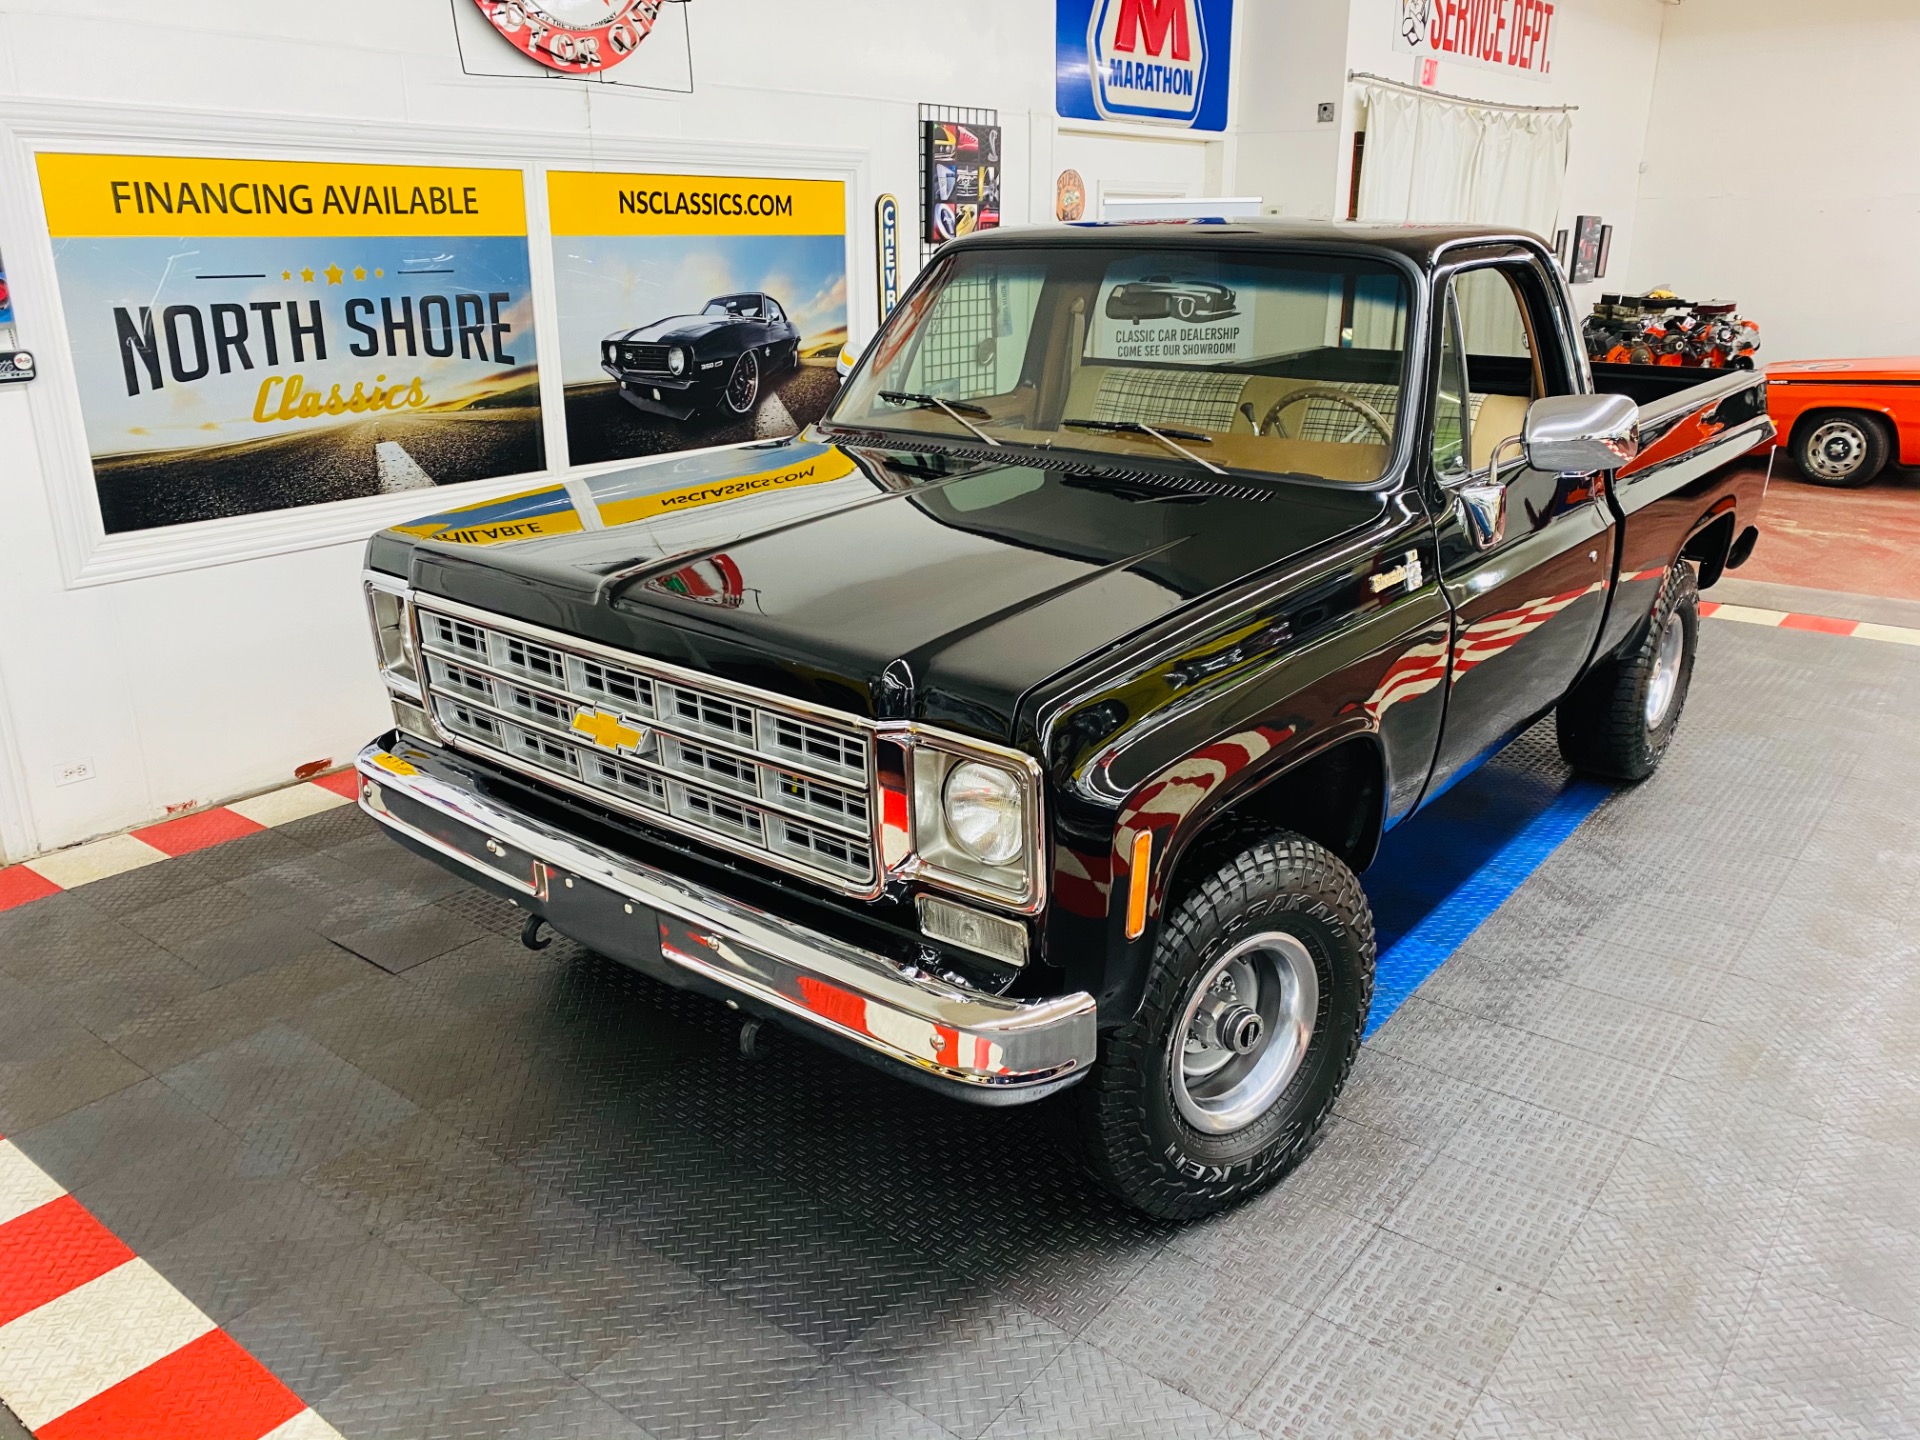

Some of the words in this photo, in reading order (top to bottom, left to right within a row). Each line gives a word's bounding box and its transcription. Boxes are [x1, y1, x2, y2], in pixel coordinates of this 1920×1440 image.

[1430, 0, 1507, 63] SERVICE
[1508, 0, 1554, 74] DEPT.
[1108, 58, 1193, 96] MARATHON
[110, 181, 313, 214] FINANCING
[322, 185, 479, 215] AVAILABLE
[618, 190, 793, 217] NSCLASSICS.COM
[883, 206, 896, 317] CHEVR
[113, 299, 328, 397] NORTH
[345, 291, 515, 365] SHORE
[1115, 329, 1155, 343] CLASSIC
[1158, 328, 1177, 342] CAR
[1180, 327, 1240, 341] DEALERSHIP
[1117, 345, 1142, 357] COME
[1144, 344, 1160, 356] SEE
[1163, 344, 1180, 356] OUR
[1182, 342, 1236, 355] SHOWROOM!
[252, 374, 430, 423] Classics
